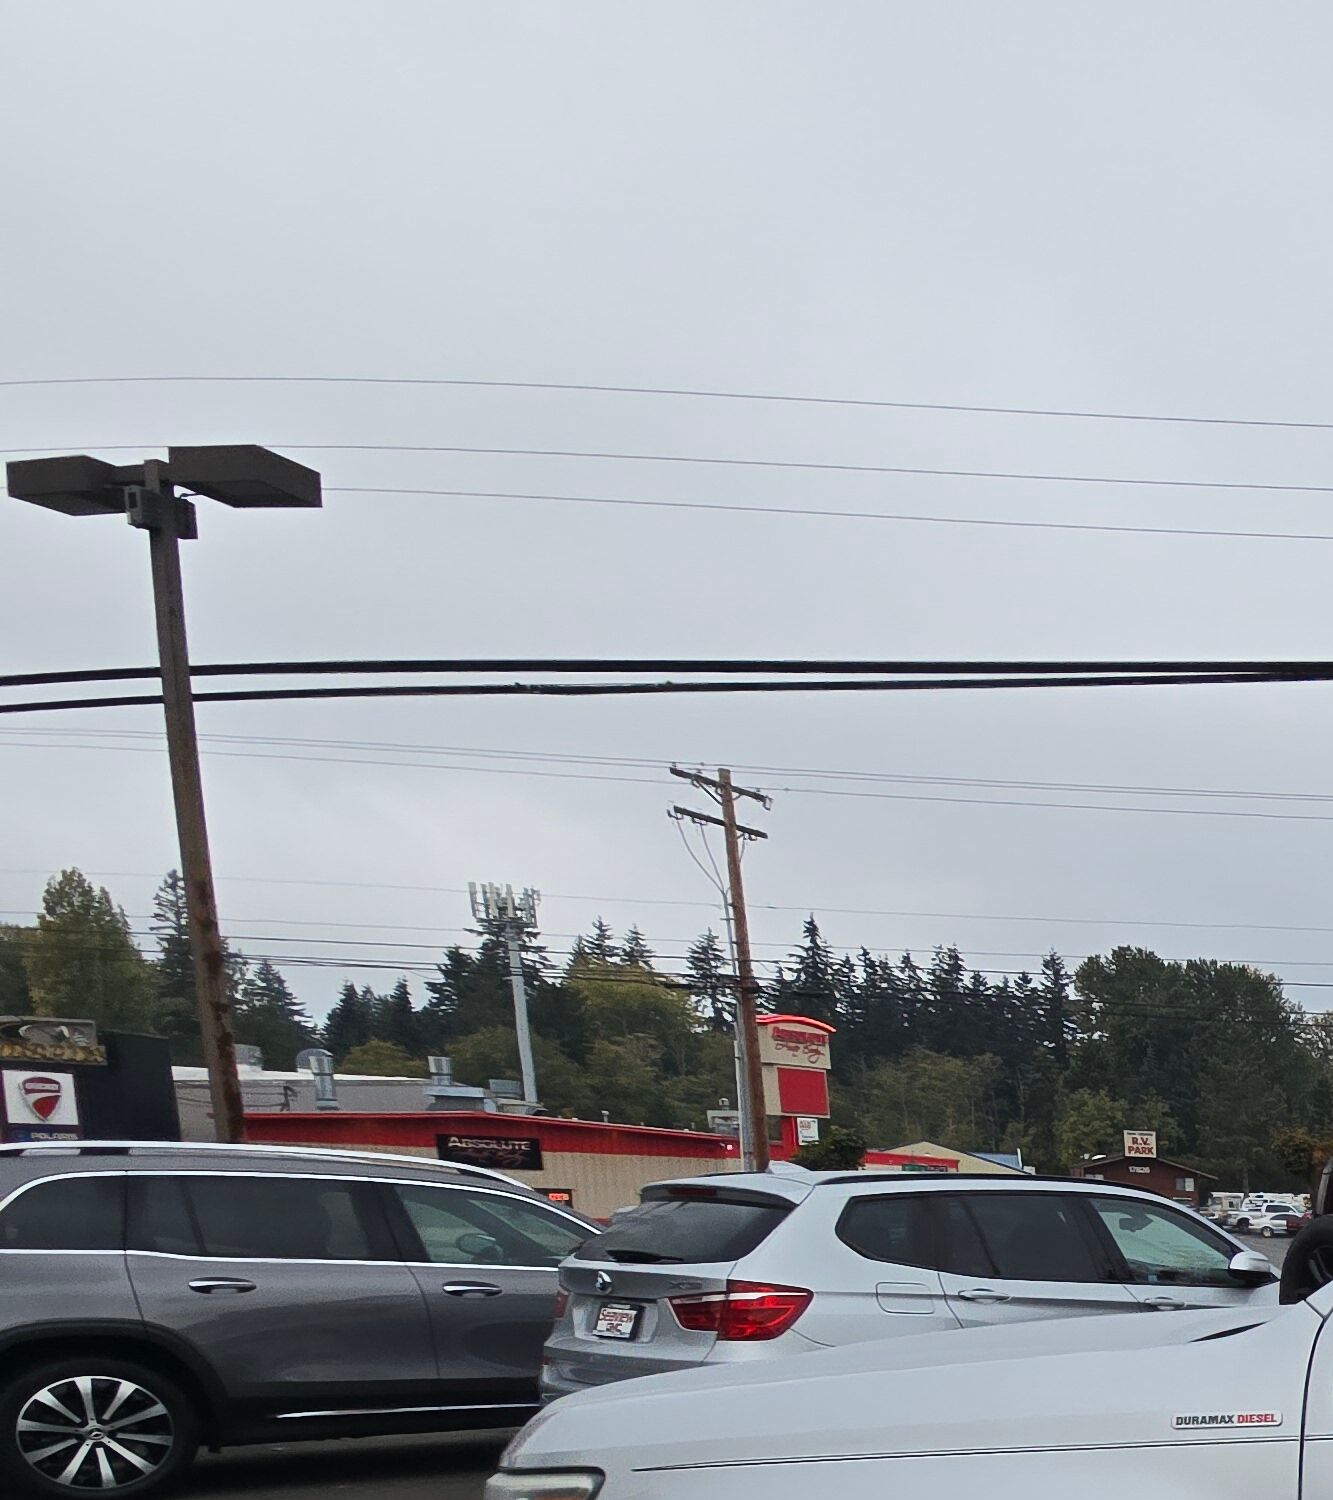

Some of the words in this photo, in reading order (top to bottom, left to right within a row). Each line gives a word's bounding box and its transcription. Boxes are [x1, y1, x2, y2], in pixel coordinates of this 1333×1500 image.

[448, 1136, 531, 1151] ABSOLUTE
[1131, 1136, 1151, 1146] R.V.
[1127, 1145, 1154, 1156] PARK
[1175, 1414, 1235, 1426] DURAMAX
[1236, 1413, 1278, 1424] DIESEL
